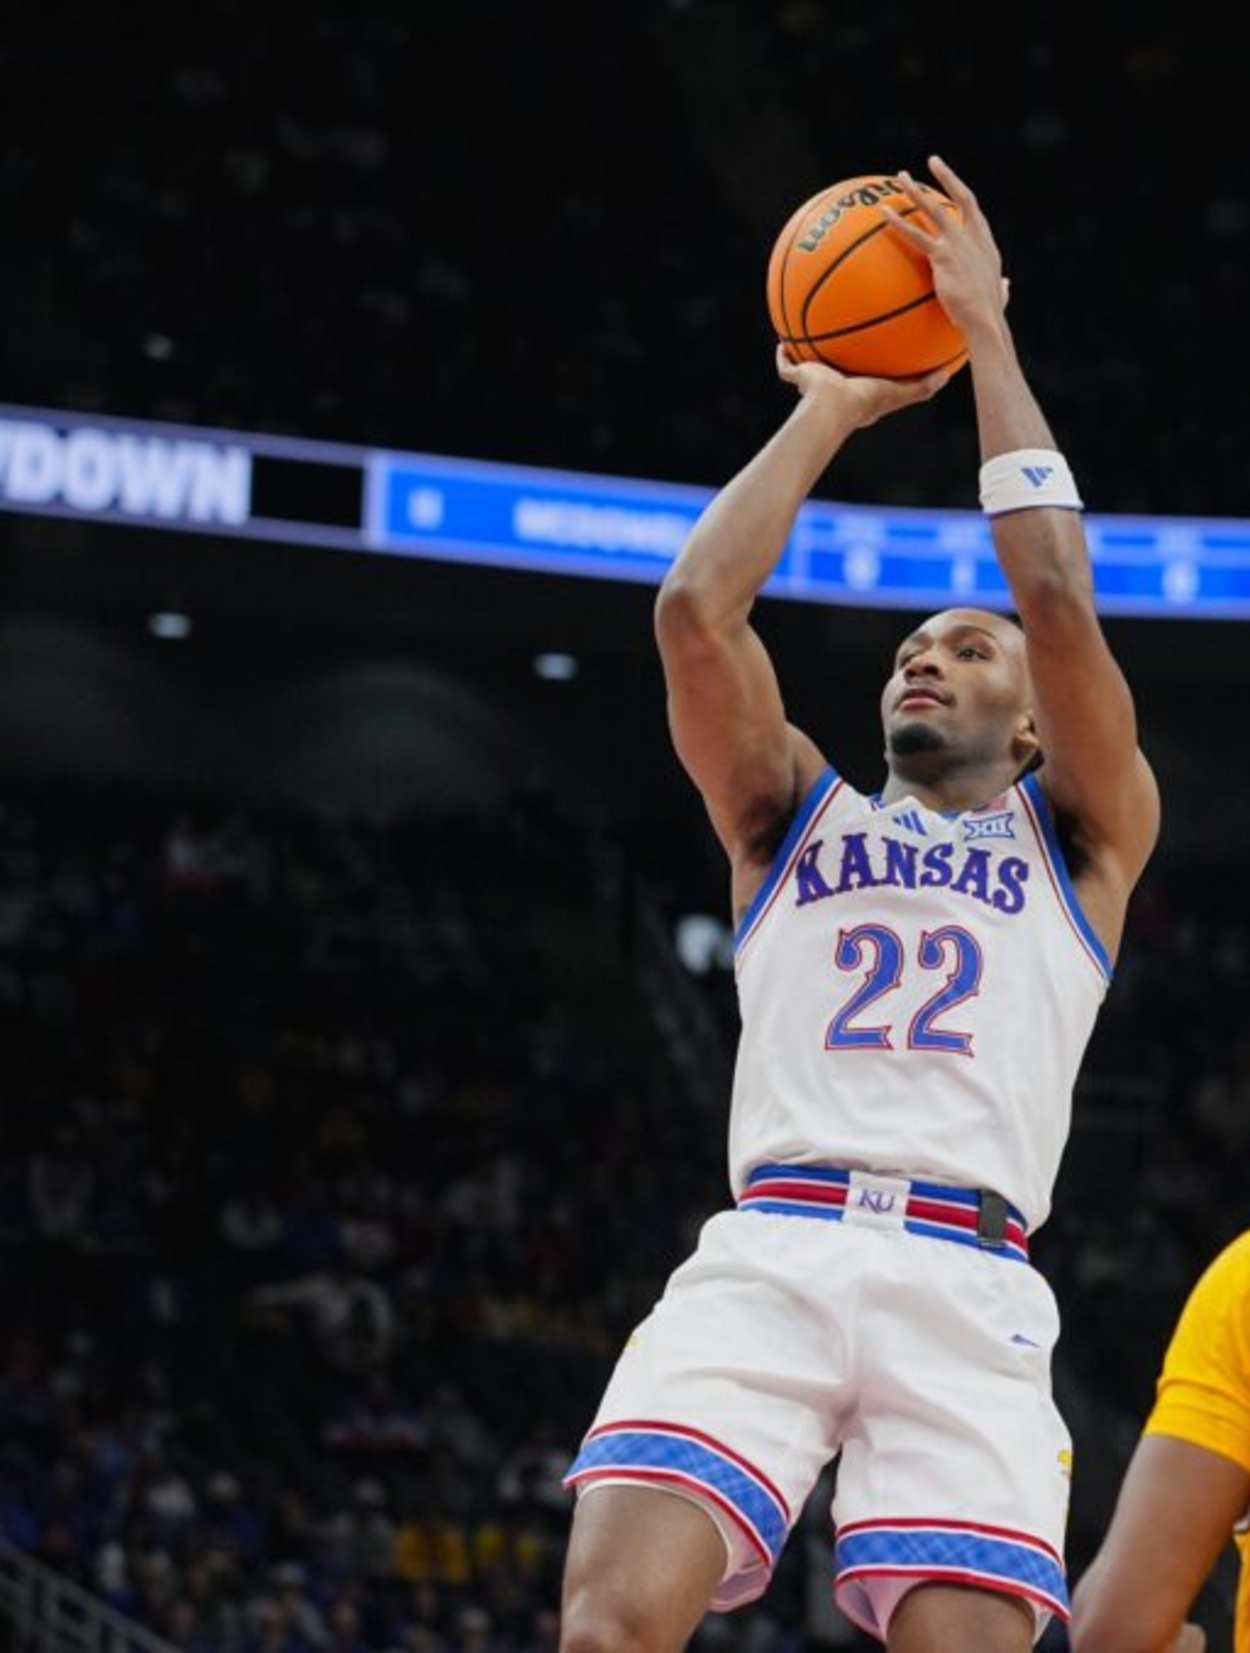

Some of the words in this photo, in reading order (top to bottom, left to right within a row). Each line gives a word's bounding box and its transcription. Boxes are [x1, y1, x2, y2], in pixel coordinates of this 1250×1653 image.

[798, 179, 929, 253] ilson
[795, 832, 1030, 915] KANSAS
[825, 922, 984, 1058] 22
[859, 1189, 896, 1214] KU
